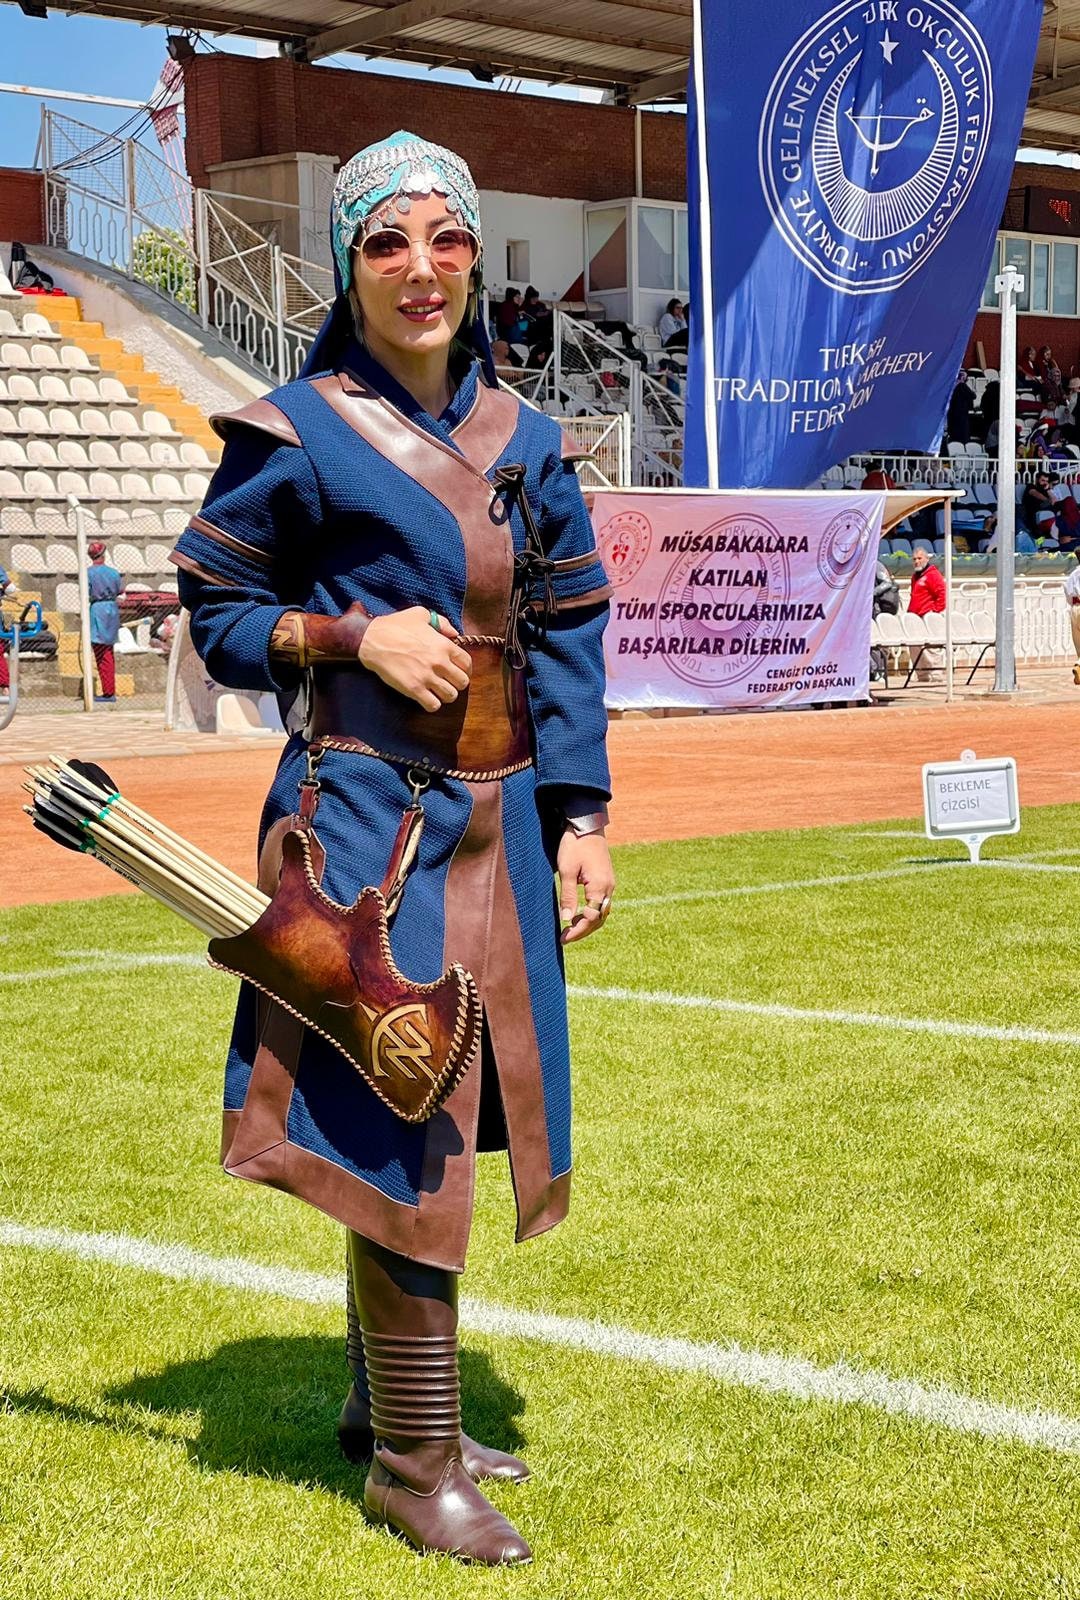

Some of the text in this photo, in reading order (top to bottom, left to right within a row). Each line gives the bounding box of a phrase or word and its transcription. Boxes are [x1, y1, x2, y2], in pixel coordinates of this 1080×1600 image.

[906, 7, 981, 107] OKÇULUK
[780, 25, 860, 183] GELENEKSEL
[882, 114, 981, 270] FEDERASYONU
[789, 383, 875, 433] FEDERION
[660, 530, 809, 553] MÜSABAKALARA
[688, 568, 768, 588] KATILAN
[616, 597, 826, 621] TÜM SPORCULARIMIZA
[618, 632, 810, 659] BAŞARILAR DİLERİM.
[766, 662, 838, 679] CENGİZ TOKSÖZ
[747, 677, 856, 693] FEDERASYON BAŞKANI
[939, 778, 992, 794] BEKLEME
[941, 796, 981, 813] ÇİZGİSİ
